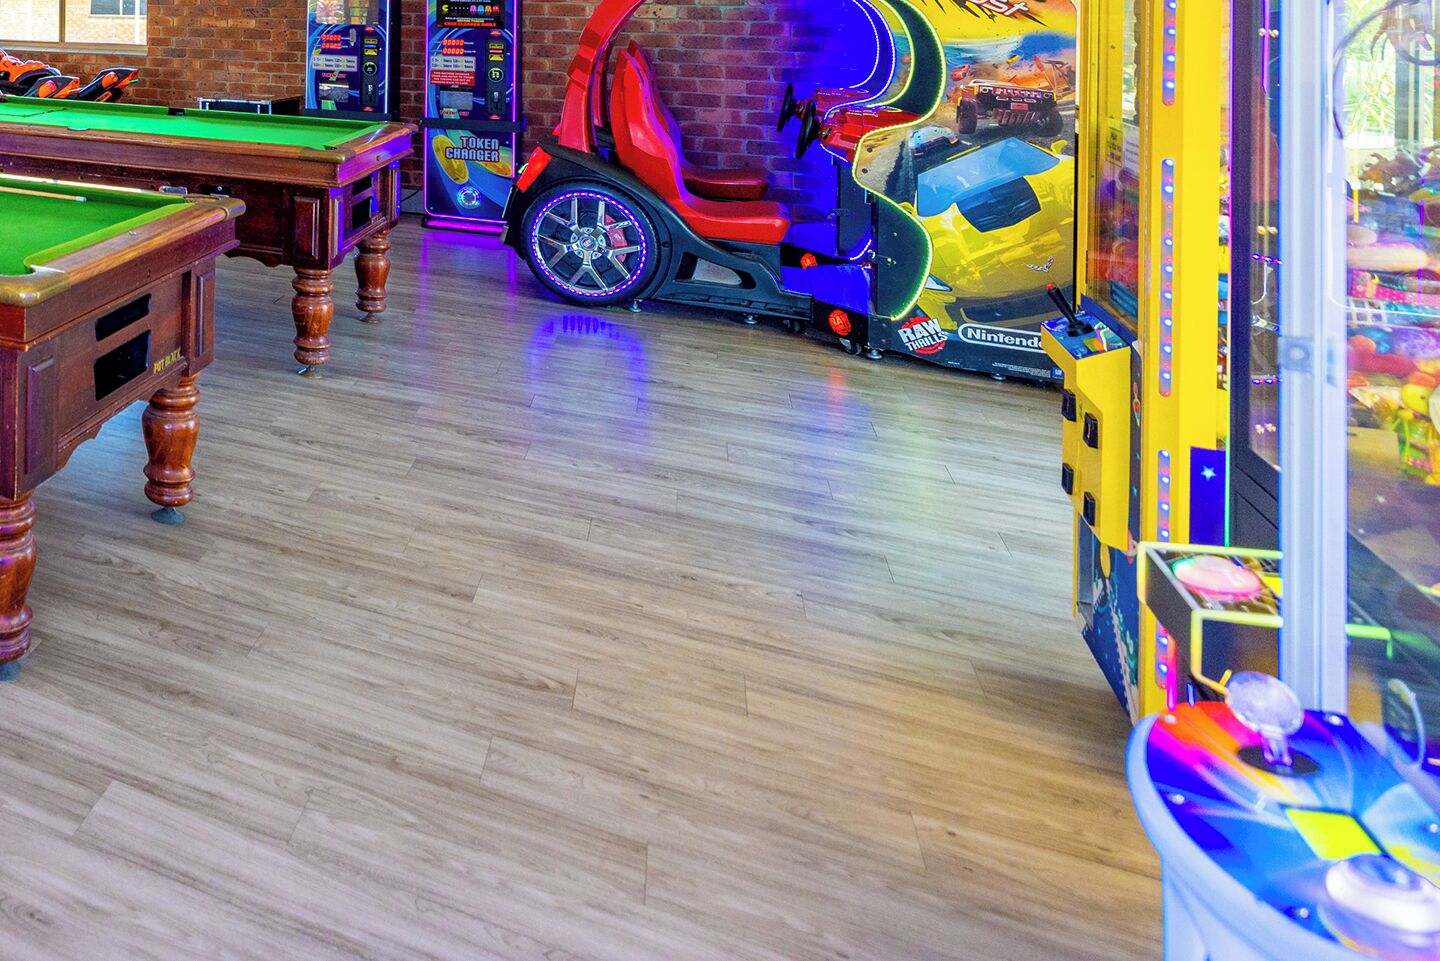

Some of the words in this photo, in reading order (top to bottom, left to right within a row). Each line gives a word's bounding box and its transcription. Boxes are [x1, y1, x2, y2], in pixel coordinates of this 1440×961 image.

[460, 136, 500, 150] TOKEN
[445, 147, 500, 162] CHANGER
[898, 318, 942, 343] RAW
[967, 327, 1042, 348] Nintend
[905, 331, 948, 351] THRILLS
